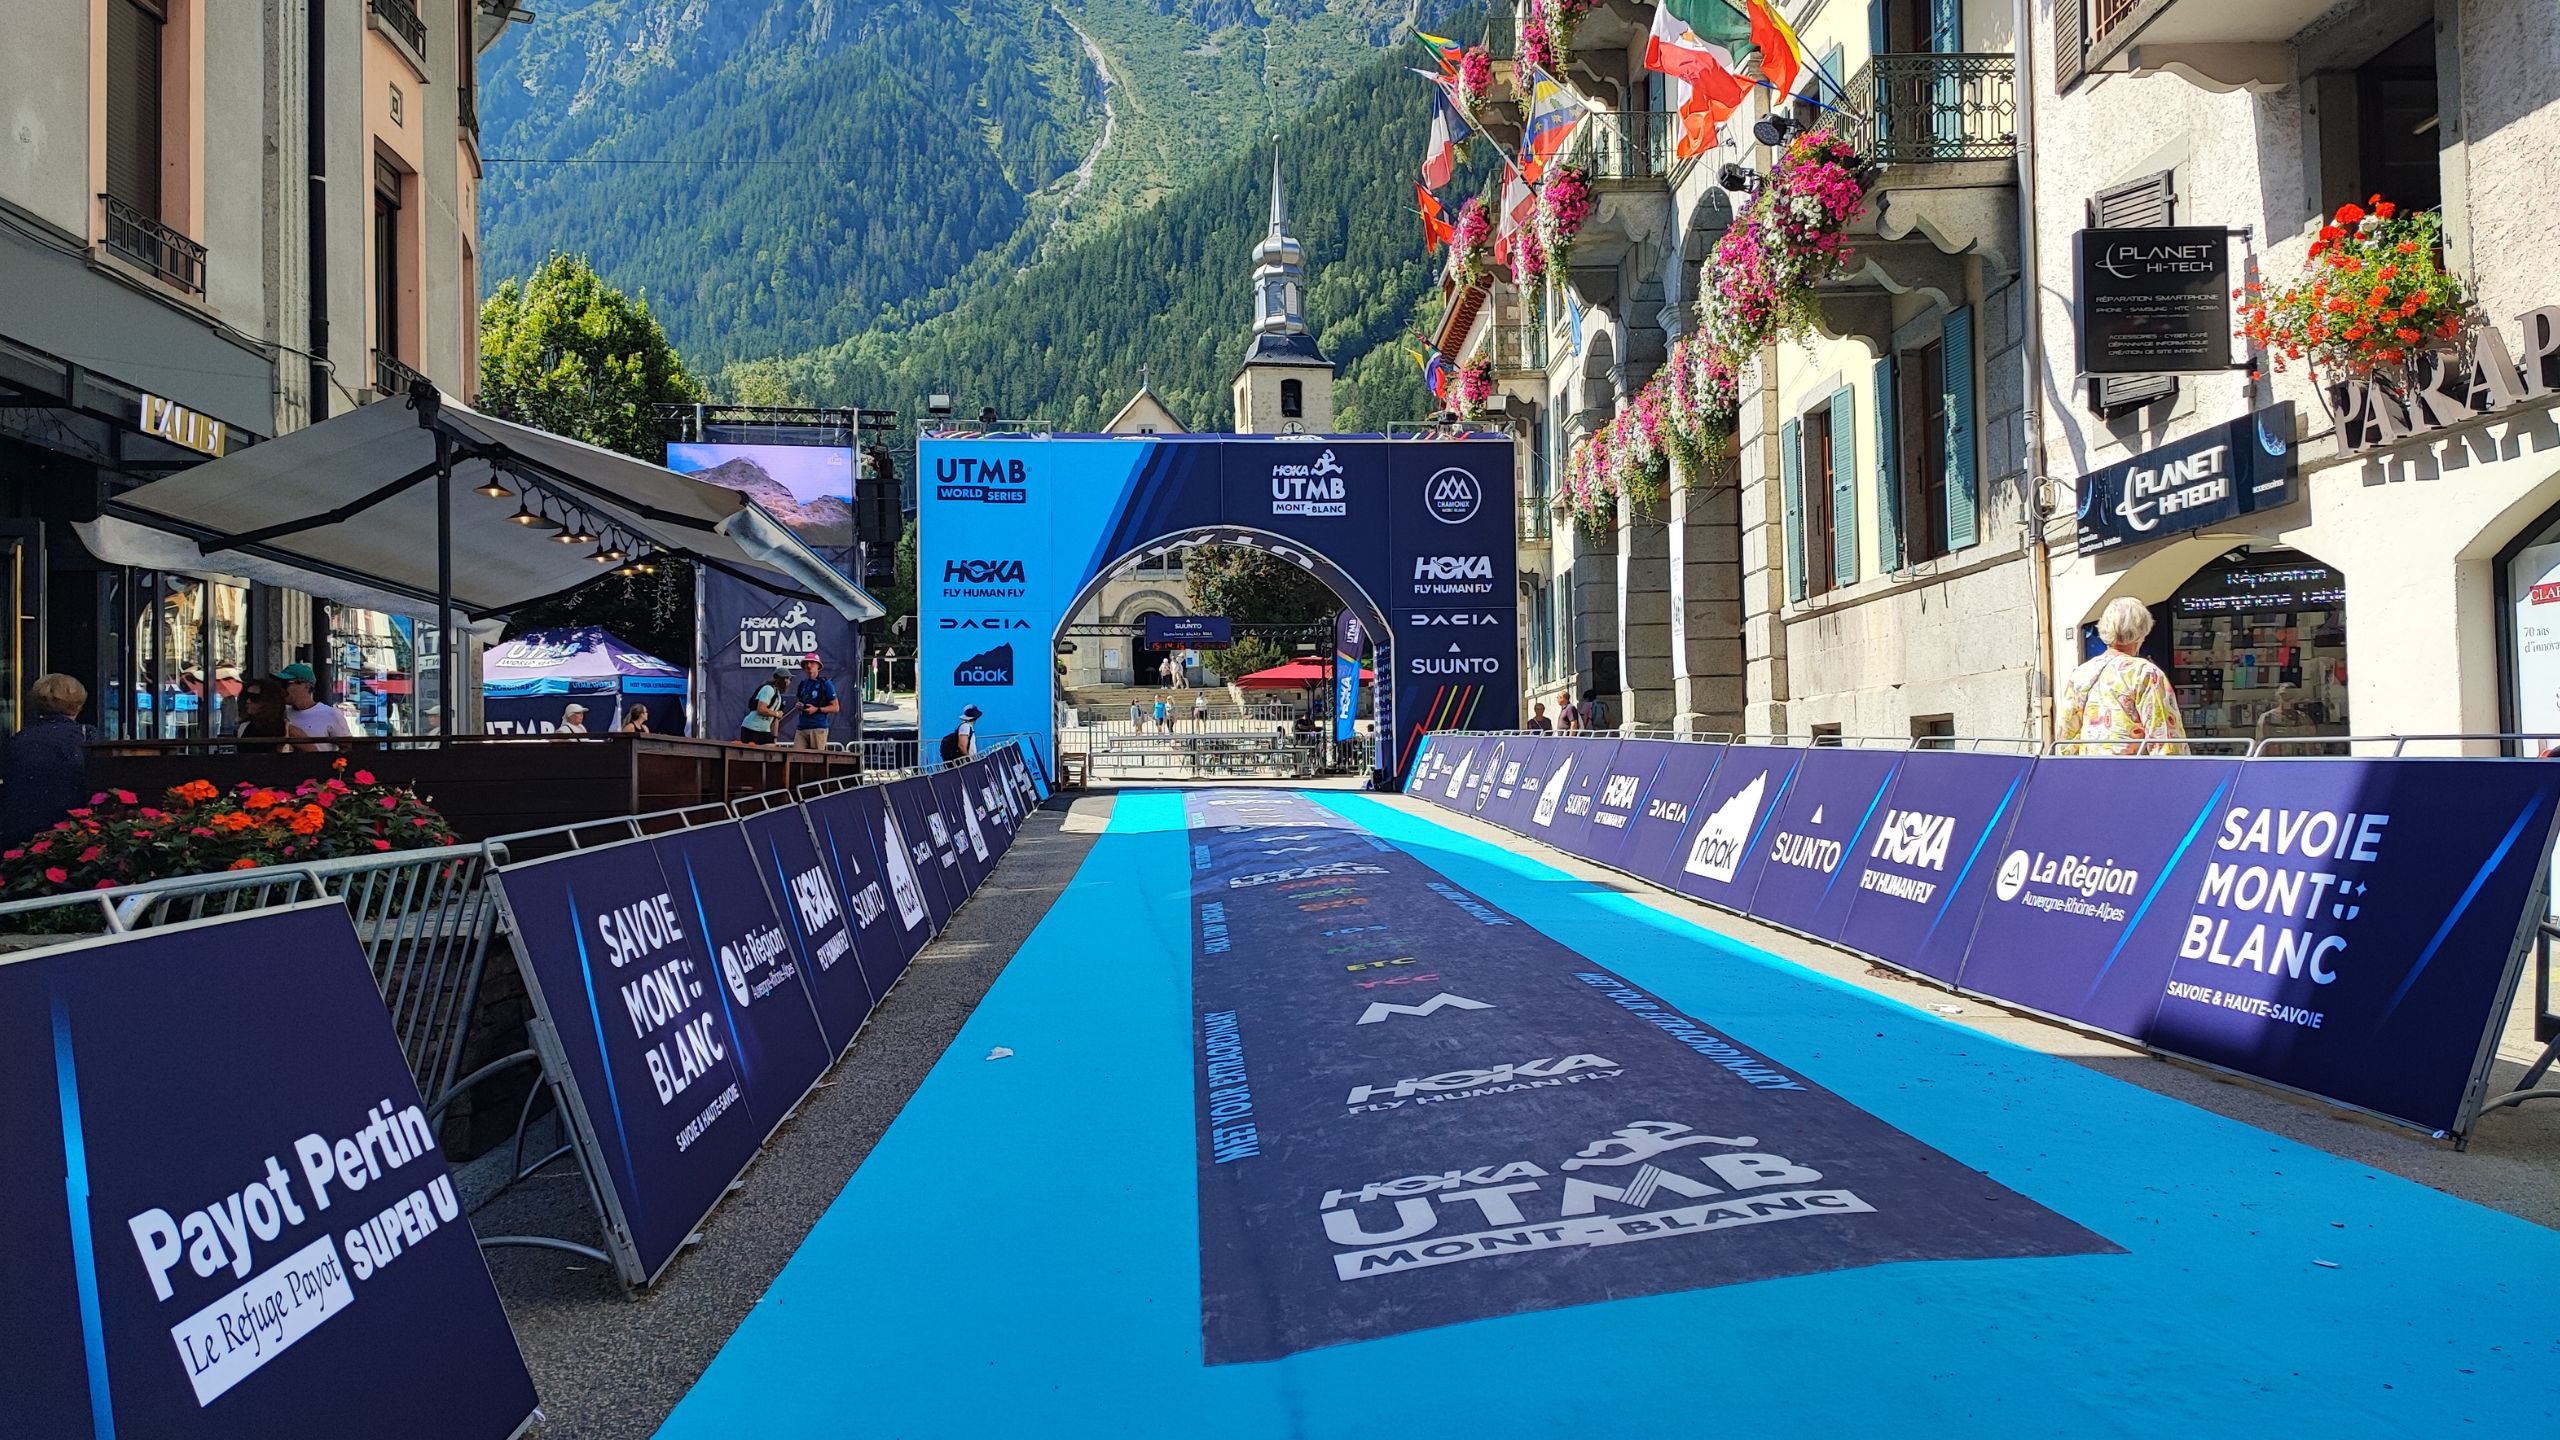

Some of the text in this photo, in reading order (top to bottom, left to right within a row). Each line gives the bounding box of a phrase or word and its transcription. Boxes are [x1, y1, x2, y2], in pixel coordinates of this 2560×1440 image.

[2119, 245, 2213, 260] PLANET
[2147, 262, 2214, 273] HI-TECH
[2095, 294, 2220, 303] RÉPARATION SMARTPHONE
[936, 458, 1026, 484] UTMB
[1272, 465, 1310, 476] HOKA
[1272, 477, 1346, 500] UTMB
[2134, 445, 2229, 498] PLANET
[940, 488, 1023, 501] WORLD SERIES
[2158, 478, 2231, 516] HI-TECH
[943, 559, 1026, 583] HOKA
[1413, 556, 1494, 580] HOKA
[1414, 583, 1493, 594] FLY HUMAN FLY
[943, 588, 1026, 598] FLY HUMAN FLY
[740, 617, 780, 629] HOKA
[939, 618, 1031, 629] DACIA
[1411, 614, 1499, 625] DACIA
[2523, 627, 2535, 638] 70
[740, 630, 818, 653] UTMB
[960, 665, 1008, 682] näak
[1411, 657, 1500, 674] SUUNTO
[1339, 676, 1352, 720] HOKA
[1601, 774, 1640, 809] HOKA
[1648, 799, 1688, 824] DACIA
[1694, 829, 1739, 870] näak
[1771, 831, 1842, 873] SUUNTO
[1870, 808, 1957, 871] HOKA
[2217, 806, 2390, 862] SAVOIE
[1860, 869, 1937, 904] FLY HUMAN FLY
[2030, 851, 2139, 897] La Région
[2197, 862, 2340, 919] MONT
[790, 865, 839, 936] HOKA
[851, 880, 886, 930] SUUNTO
[2021, 890, 2126, 922] Auvergne-Rhône-Alpes
[598, 893, 684, 968] SAVOIE
[732, 924, 786, 974] La Région
[2180, 915, 2348, 985] BLANC
[1346, 957, 1417, 971] ETC
[621, 958, 692, 1039] MONT
[2167, 981, 2325, 1029] SAVOIE & HAUTE-SAVOIE
[1203, 1009, 1249, 1088] EXTRAORDINARY
[1571, 972, 1809, 1091] MEET YOUR EXTRAORDINARY
[645, 1012, 724, 1106] BLANC
[1346, 1053, 1620, 1104] HOKA
[1210, 1083, 1254, 1127] YOUR
[1348, 1069, 1625, 1115] FLY HUMAN FLY
[1212, 1122, 1261, 1164] MEET
[127, 1097, 436, 1303] Payot Pertin
[1319, 1161, 1552, 1210] HOKA
[1320, 1152, 1824, 1247] UTMB
[343, 1173, 459, 1281] SUPER U
[183, 1253, 342, 1376] Le Refuge Payot
